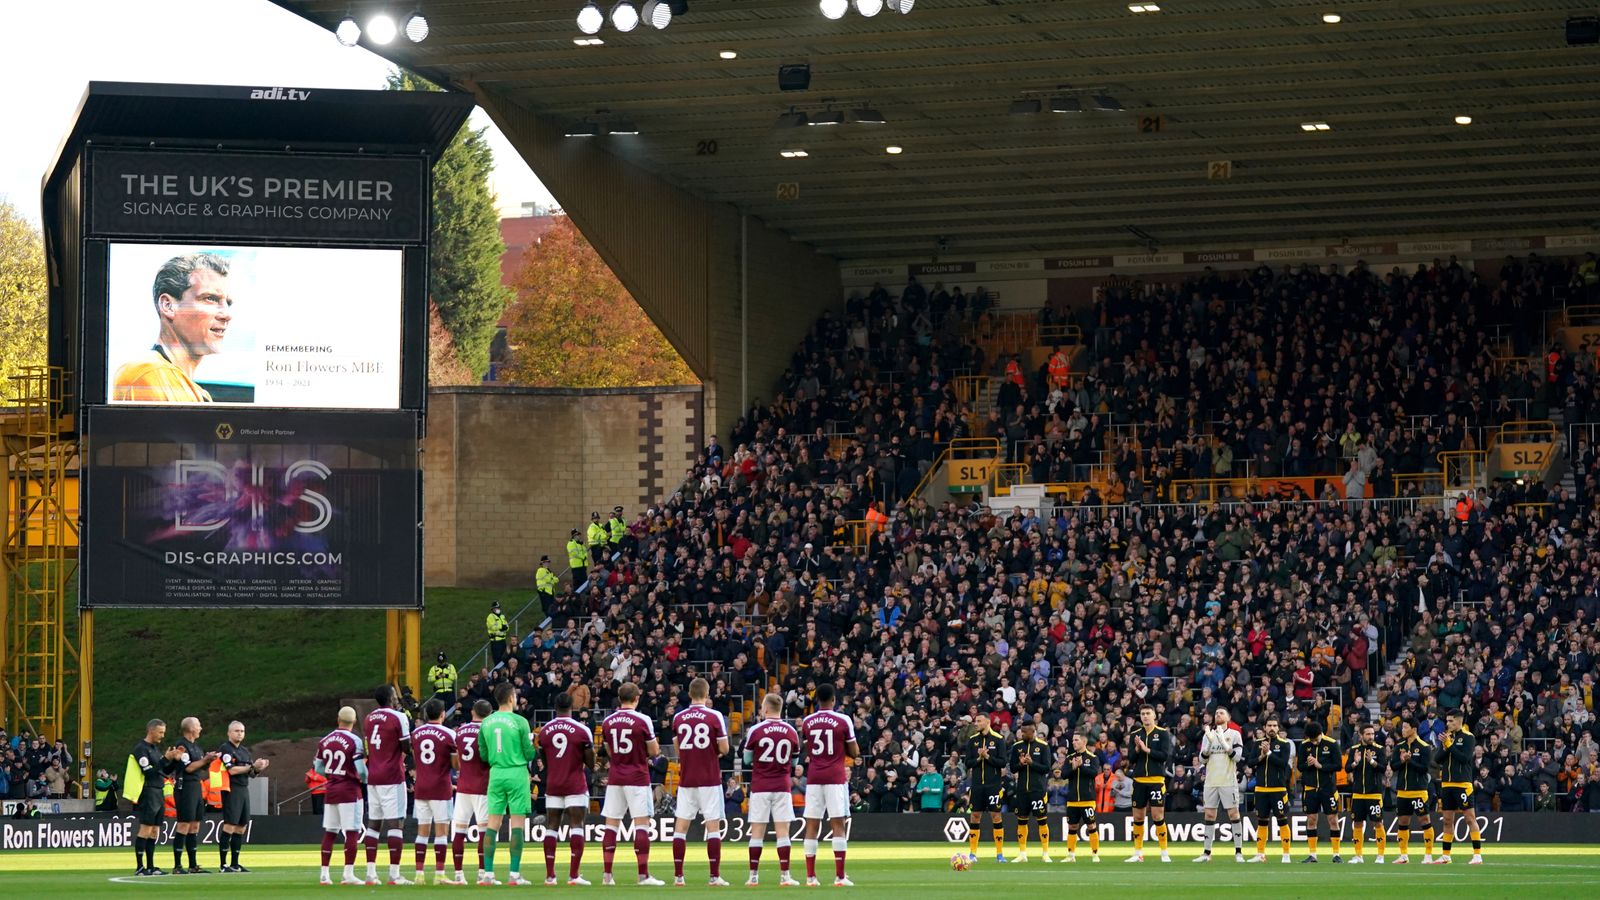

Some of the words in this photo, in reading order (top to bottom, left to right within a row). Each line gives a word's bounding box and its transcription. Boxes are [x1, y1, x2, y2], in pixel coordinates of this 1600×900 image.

[250, 86, 311, 102] adi.tv
[1142, 116, 1160, 133] 21
[696, 139, 718, 156] 20
[1211, 162, 1228, 179] 21
[121, 174, 178, 196] THE
[189, 175, 253, 198] UK'S
[264, 177, 393, 201] PREMIER
[778, 184, 798, 200] 20
[122, 201, 197, 216] SIGNAGE
[202, 203, 213, 217] &
[218, 204, 303, 219] GRAPHICS
[308, 206, 392, 221] COMPANY
[1197, 253, 1225, 262] FOSUN
[1268, 250, 1296, 258] FOSUN
[921, 265, 947, 273] FOSUN
[1057, 259, 1085, 268] FOSUN
[265, 344, 333, 353] REMEMBERING
[266, 360, 292, 372] Ron
[297, 360, 348, 373] Flowers
[352, 361, 384, 374] MBE
[240, 428, 259, 436] Official
[261, 428, 274, 436] Print
[275, 429, 296, 437] Partner
[1513, 450, 1543, 465] SL2
[960, 466, 986, 480] SL1
[175, 459, 332, 533] DIS
[165, 551, 342, 566] DIS-GRAPHICS.COM
[608, 716, 636, 726] DAWSON
[806, 717, 839, 728] JOHNSON
[545, 724, 576, 735] ANTONIO
[678, 722, 711, 750] 28
[763, 725, 789, 735] BOWEN
[370, 724, 382, 750] 4
[493, 727, 502, 753] 1
[610, 728, 633, 755] 15
[810, 729, 834, 756] 31
[420, 738, 436, 765] 8
[461, 736, 476, 762] 3
[552, 732, 568, 759] 9
[758, 737, 792, 765] 20
[322, 748, 346, 776] 22
[988, 795, 999, 805] 27
[1150, 790, 1162, 800] 23
[1460, 793, 1468, 803] 9
[1031, 800, 1044, 810] 22
[1277, 800, 1284, 810] 8
[1330, 798, 1336, 807] 3
[1370, 805, 1382, 814] 28
[1411, 799, 1424, 809] 26
[6, 804, 15, 816] 17
[1084, 807, 1095, 818] 10
[3, 823, 34, 849] Ron
[38, 822, 95, 849] Flowers
[98, 822, 132, 847] MBE
